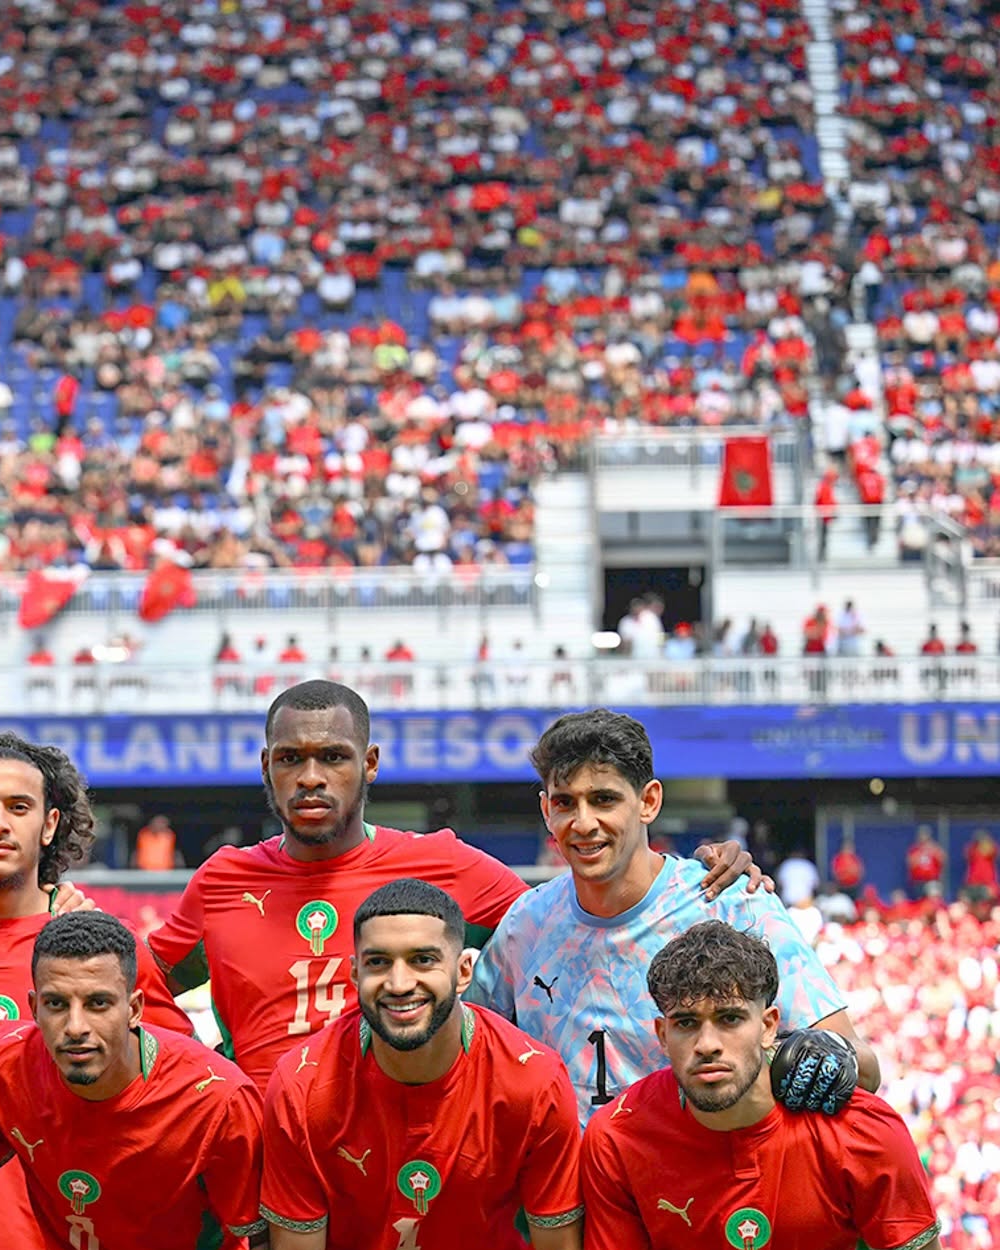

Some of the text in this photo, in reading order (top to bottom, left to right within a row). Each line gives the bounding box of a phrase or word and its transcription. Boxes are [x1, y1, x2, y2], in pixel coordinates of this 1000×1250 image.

[370, 715, 558, 770] RESO
[288, 957, 347, 1035] 14
[587, 1025, 616, 1106] 1
